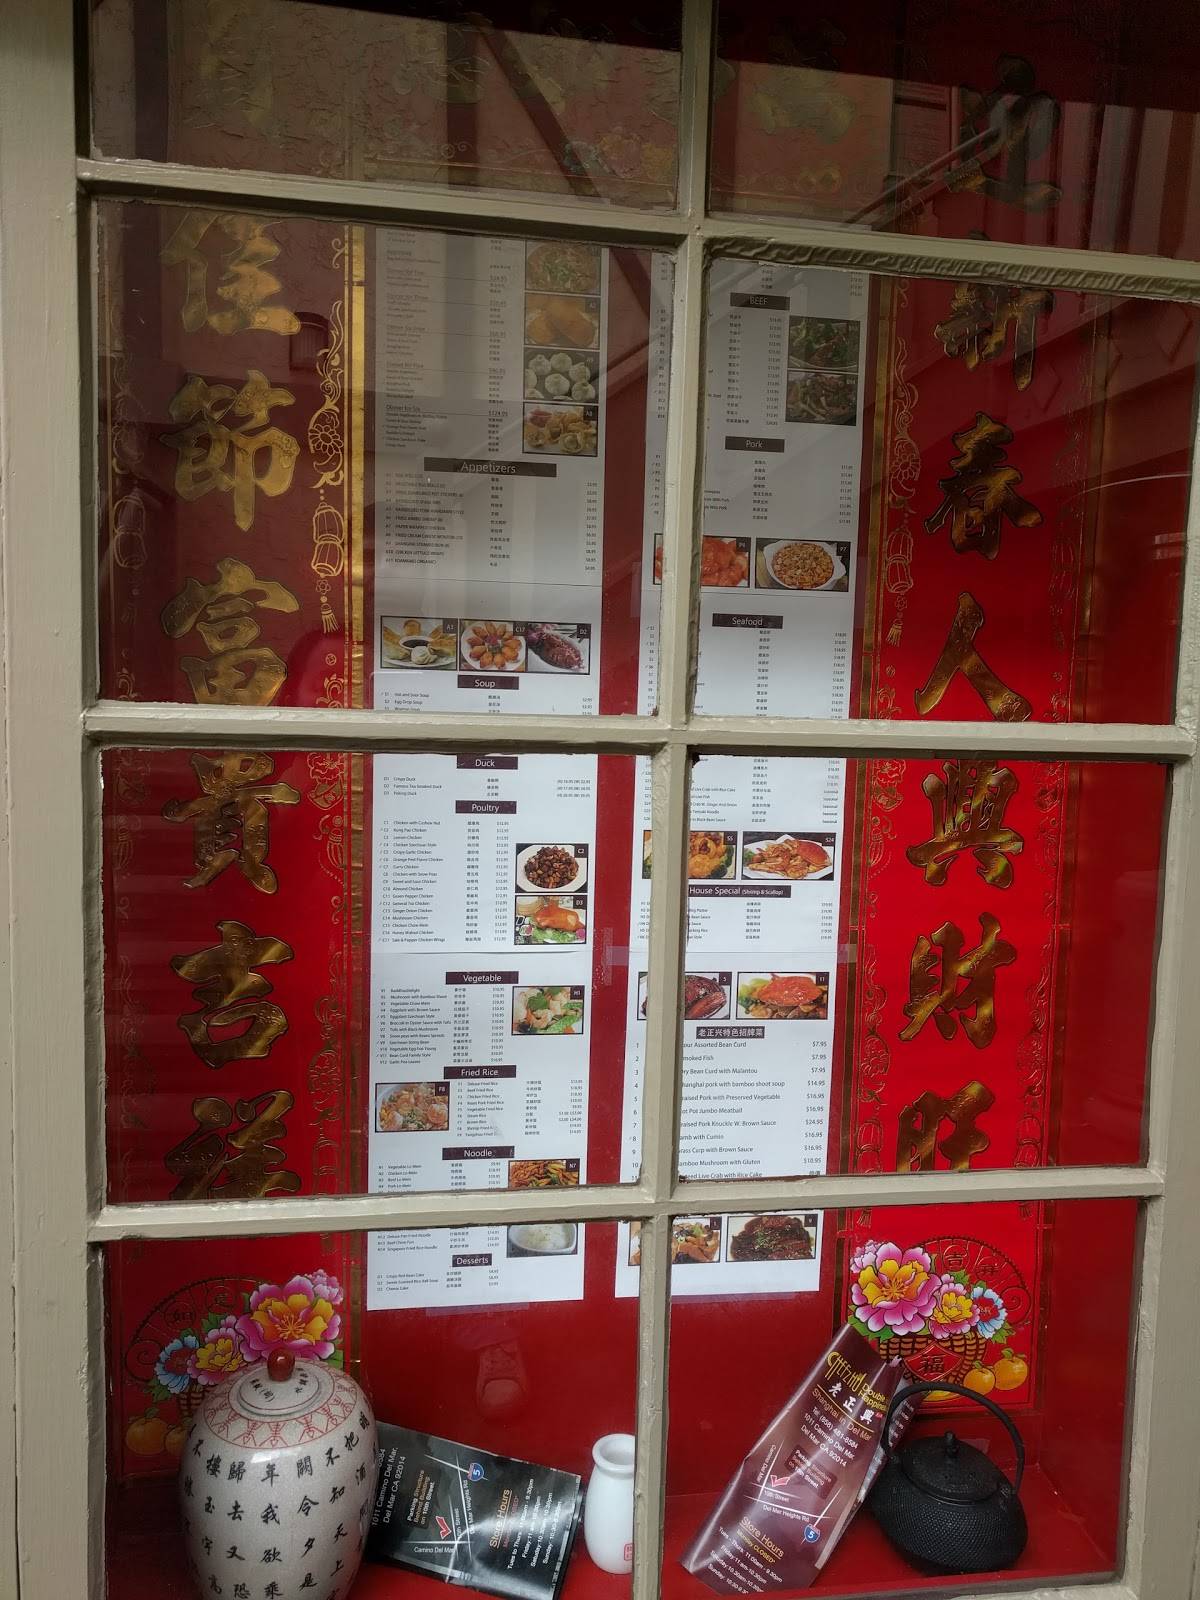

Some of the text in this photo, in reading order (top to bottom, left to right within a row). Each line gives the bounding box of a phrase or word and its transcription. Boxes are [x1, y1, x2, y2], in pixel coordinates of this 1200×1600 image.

[461, 462, 516, 474] Appetizers
[732, 617, 762, 626] Seafood
[474, 680, 495, 688] Soup
[472, 804, 499, 812] Poultry
[715, 886, 740, 896] Special
[463, 974, 501, 983] Vegetable
[457, 1256, 488, 1265] Desserts
[812, 1389, 839, 1419] Shanghai
[847, 1422, 860, 1436] Del
[376, 1478, 388, 1506] Camino
[384, 1463, 392, 1476] Del
[383, 1455, 405, 1522] Del Mar CA 92014
[489, 1488, 510, 1547] Store Hours
[740, 1516, 786, 1556] Store Hours
[507, 1554, 515, 1568] Tues
